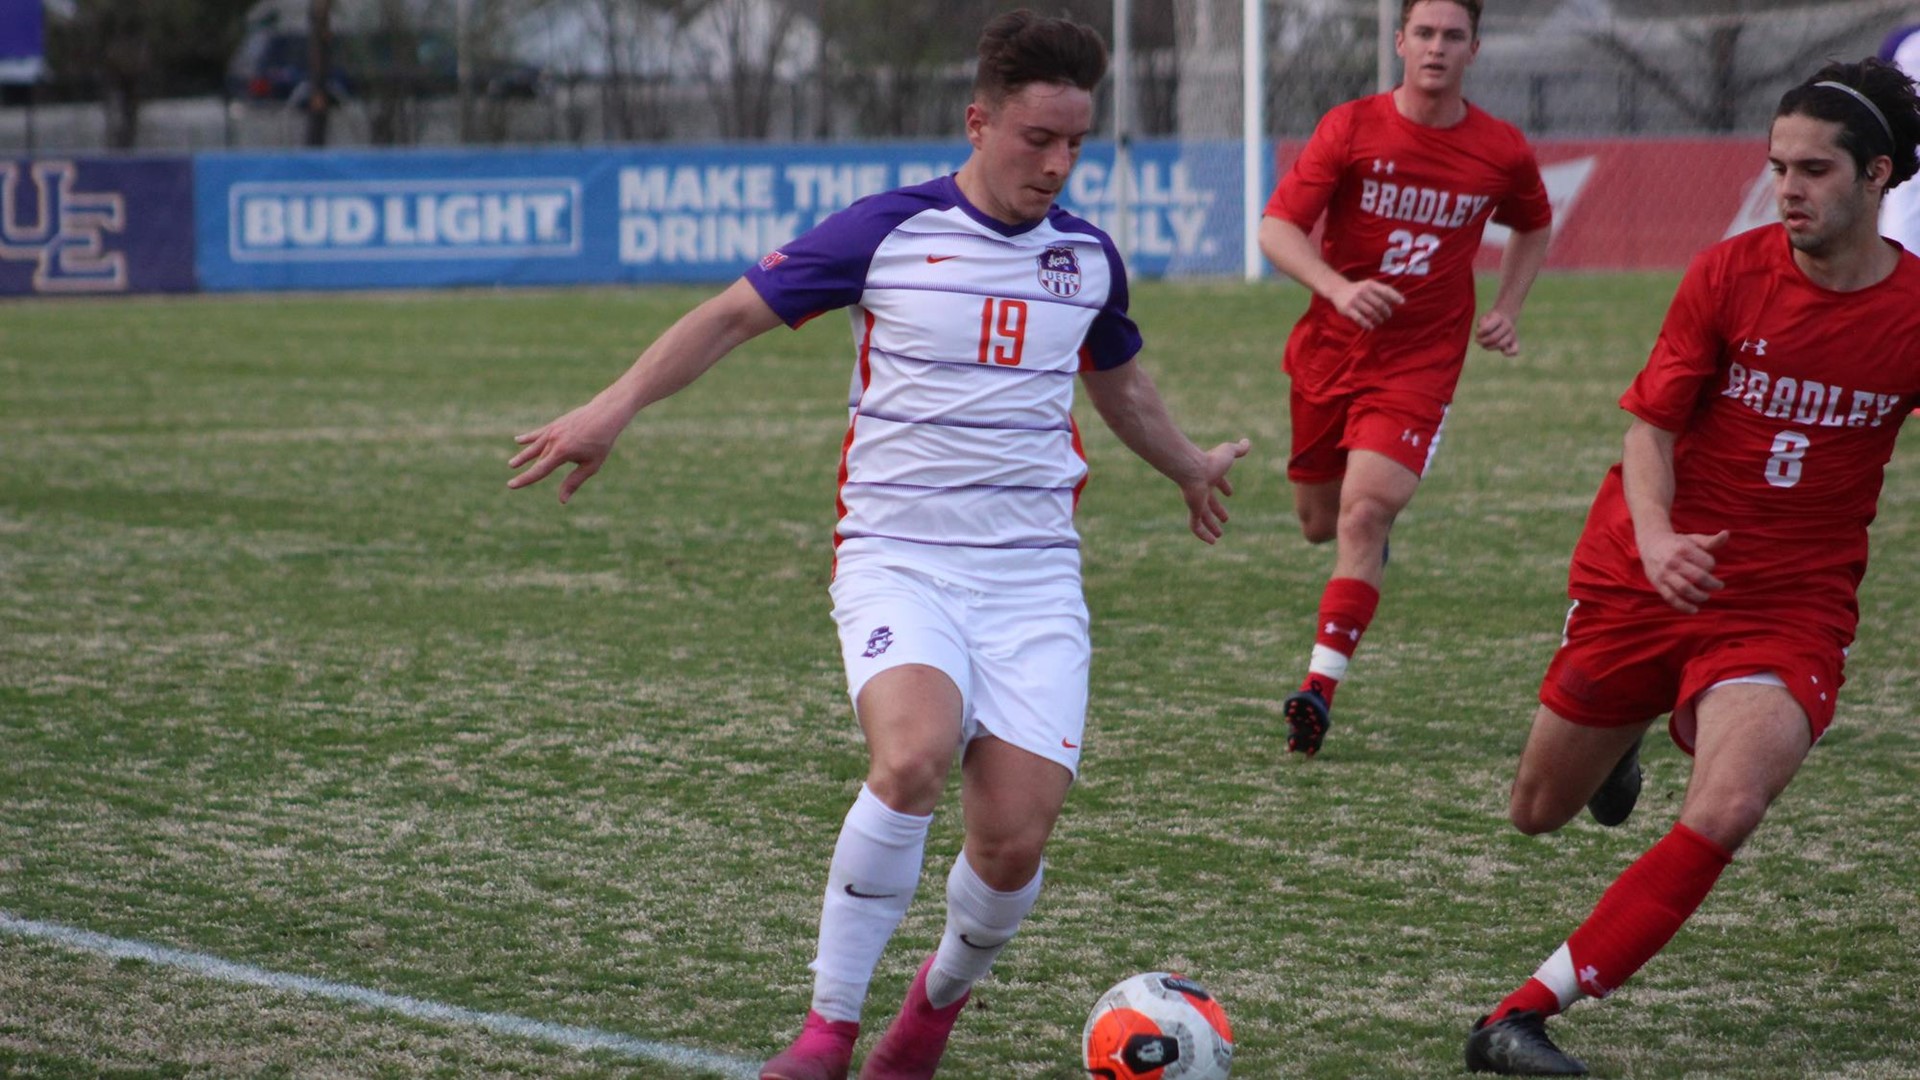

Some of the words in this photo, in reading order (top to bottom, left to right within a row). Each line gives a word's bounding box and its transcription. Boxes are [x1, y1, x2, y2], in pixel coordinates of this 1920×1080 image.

[619, 165, 774, 211] MAKE
[786, 165, 886, 210] THE
[1069, 161, 1215, 206] CALL.
[1360, 178, 1489, 229] BRADLEY
[243, 197, 375, 246] BUD
[385, 194, 564, 246] LIGHT
[619, 212, 799, 263] DRINK
[1046, 270, 1076, 284] UEFC
[1379, 229, 1440, 276] 22
[977, 296, 1028, 367] 19
[1721, 361, 1900, 427] BRADLEY
[1764, 429, 1810, 488] 8
